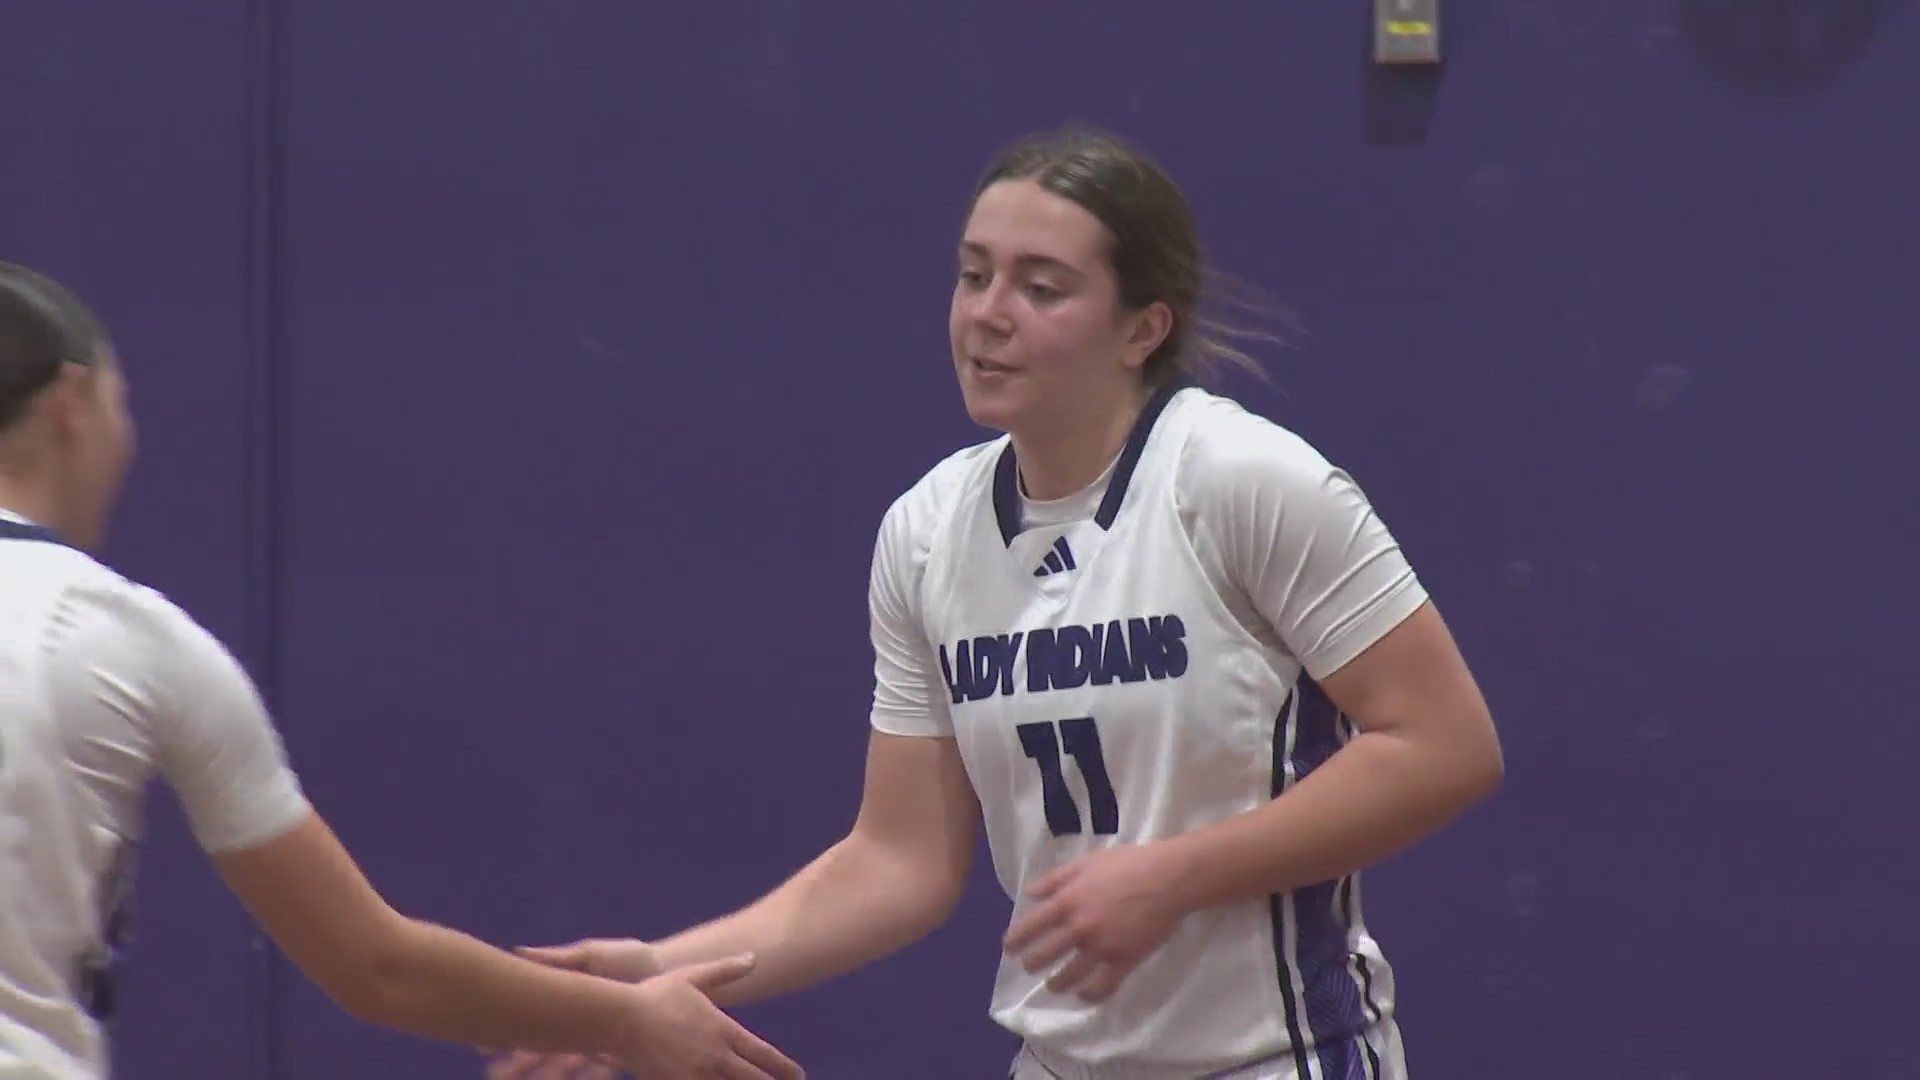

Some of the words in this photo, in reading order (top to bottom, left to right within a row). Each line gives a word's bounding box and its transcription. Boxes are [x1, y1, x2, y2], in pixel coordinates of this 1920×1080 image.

[939, 632, 1024, 703] LADY
[1026, 614, 1188, 693] INDIANS
[1016, 717, 1119, 836] 11
